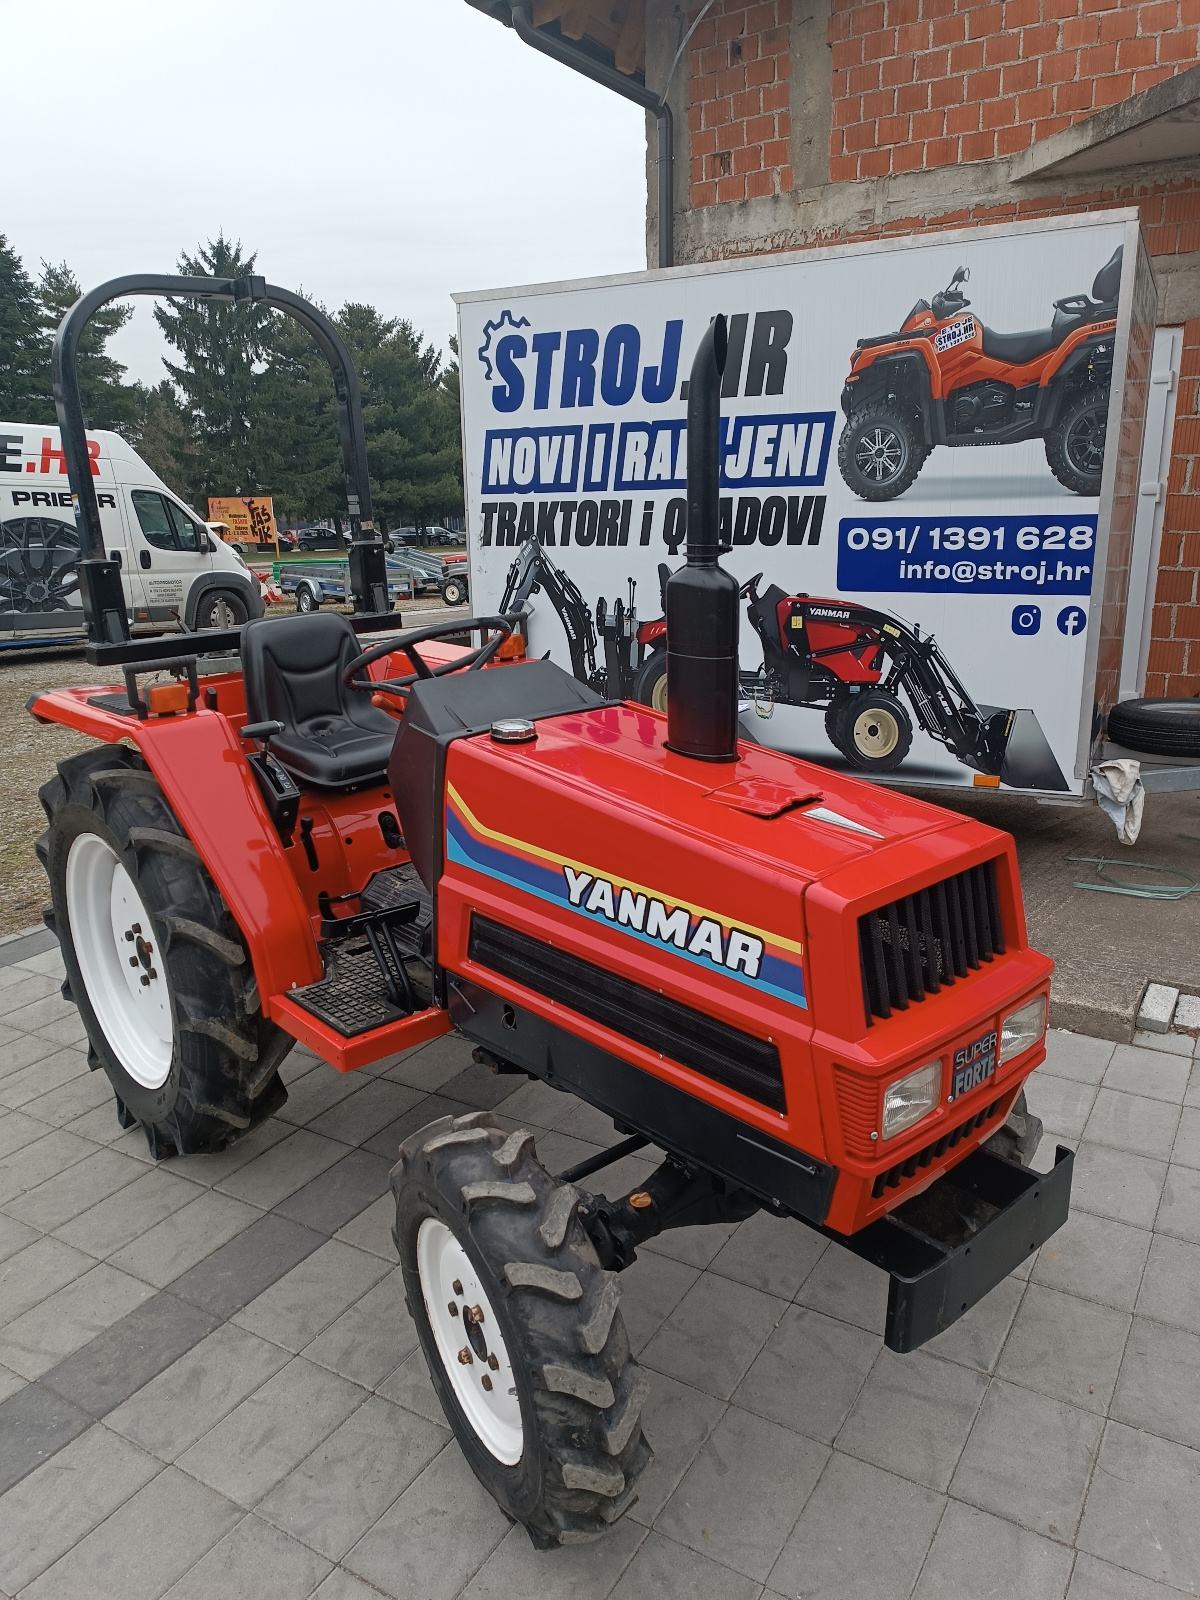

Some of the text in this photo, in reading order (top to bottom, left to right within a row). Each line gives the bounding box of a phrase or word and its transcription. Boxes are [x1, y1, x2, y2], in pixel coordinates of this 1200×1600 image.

[487, 433, 577, 487] NOVI
[621, 421, 827, 483] RAJENI
[11, 490, 117, 509] PRIBR
[481, 495, 828, 556] TRAKTORI i QADOVI
[847, 525, 1094, 554] 091/ 1391 628
[899, 560, 1091, 585] info@stroj.hr
[561, 606, 577, 640] YANMAR
[809, 607, 851, 619] YANMAR
[563, 864, 766, 979] YANMAR
[955, 1031, 998, 1070] SUPER
[954, 1055, 996, 1099] FORTE
